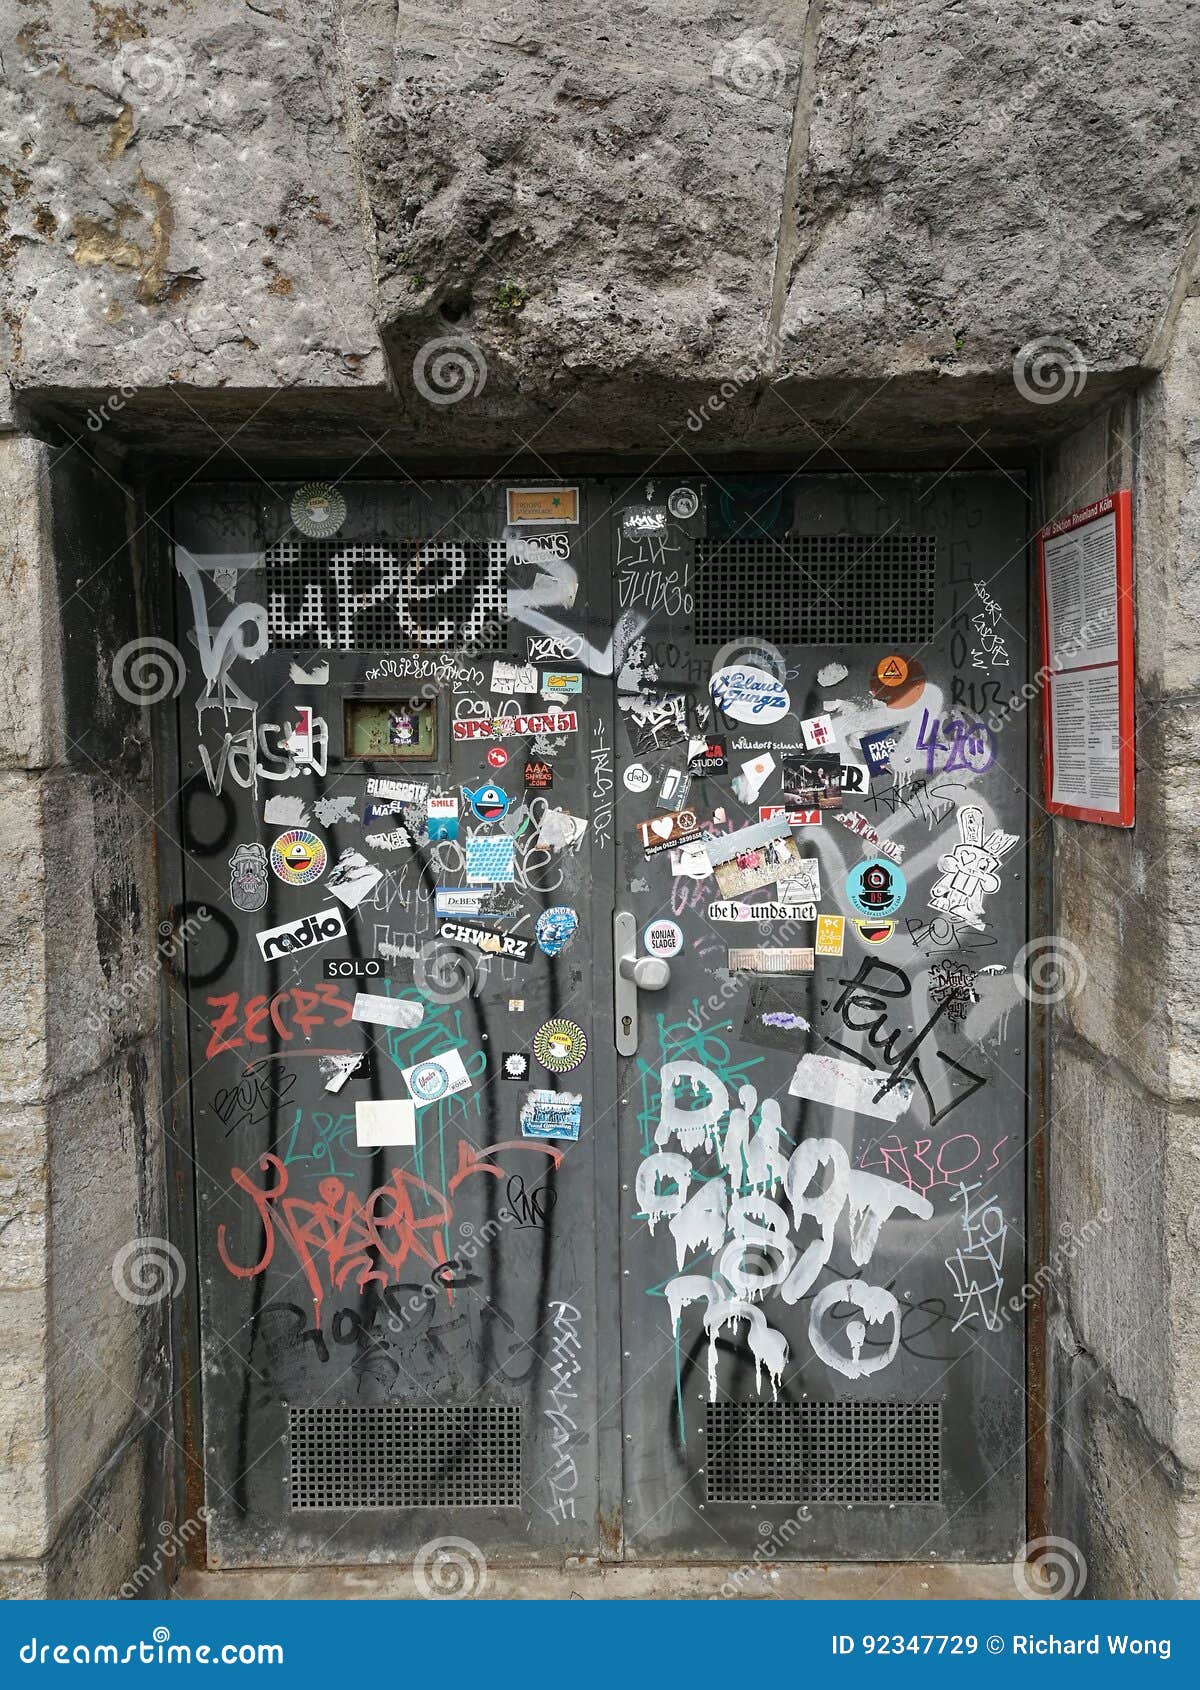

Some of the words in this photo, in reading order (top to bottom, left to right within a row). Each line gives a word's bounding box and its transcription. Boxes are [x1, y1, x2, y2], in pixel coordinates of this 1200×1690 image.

[1099, 497, 1113, 513] Köln
[454, 720, 493, 739] SPS
[514, 714, 555, 735] CGN
[916, 707, 996, 776] 420
[692, 758, 724, 767] STUDIO
[431, 799, 454, 808] SMILE
[263, 916, 341, 959] radio
[435, 922, 529, 957] CHWARZ
[651, 929, 675, 939] KONJAK
[651, 938, 676, 948] SLADGE
[817, 945, 840, 953] YAKU
[328, 961, 380, 976] SOLO
